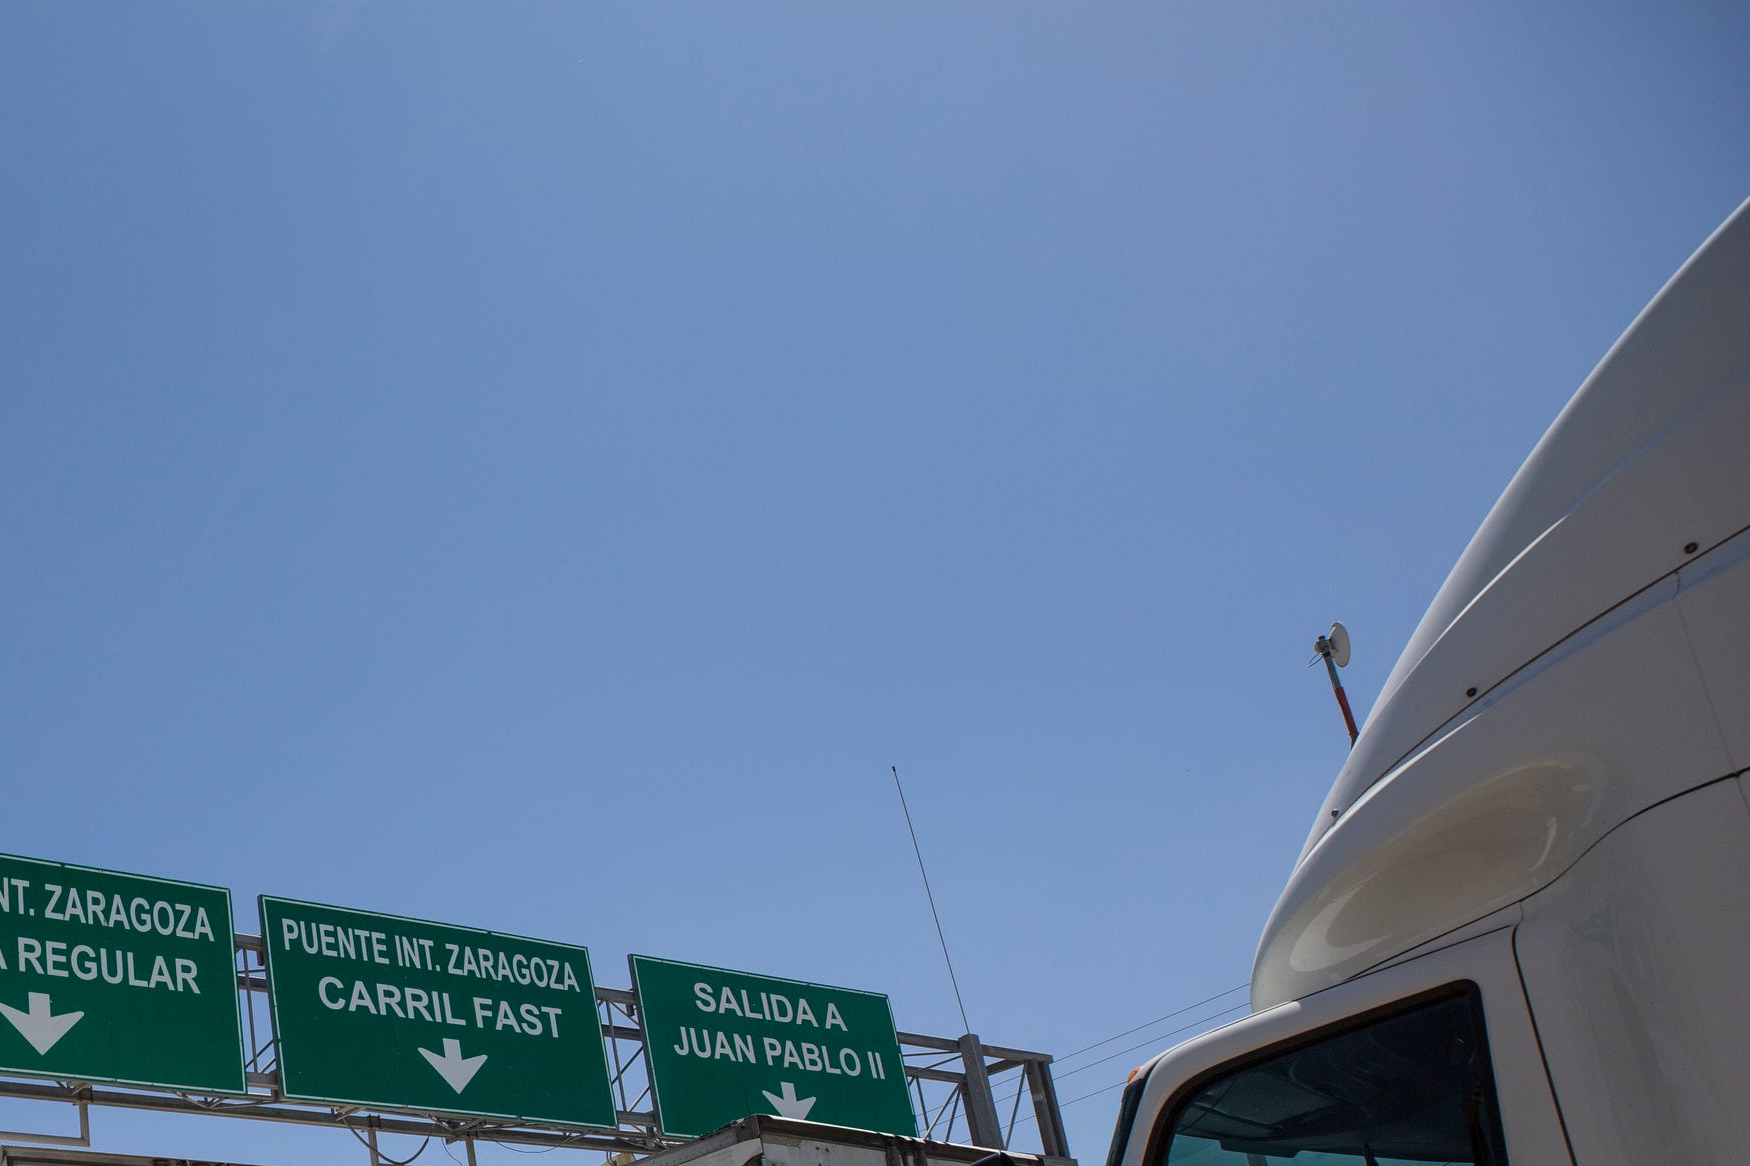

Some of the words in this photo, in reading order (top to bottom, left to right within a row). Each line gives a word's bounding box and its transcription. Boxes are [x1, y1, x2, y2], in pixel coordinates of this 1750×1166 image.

[44, 883, 216, 942] ZARAGOZA
[18, 936, 201, 994] REGULAR
[282, 918, 390, 965] PUENTE
[394, 935, 441, 972] INT.
[445, 943, 581, 993] ZARAGOZA
[318, 976, 467, 1027] CARRIL
[473, 996, 563, 1038] FAST
[693, 982, 819, 1028] SALIDA
[825, 1002, 849, 1032] A
[674, 1026, 757, 1064] JUAN
[763, 1037, 862, 1077] PABLO
[866, 1051, 886, 1080] II
